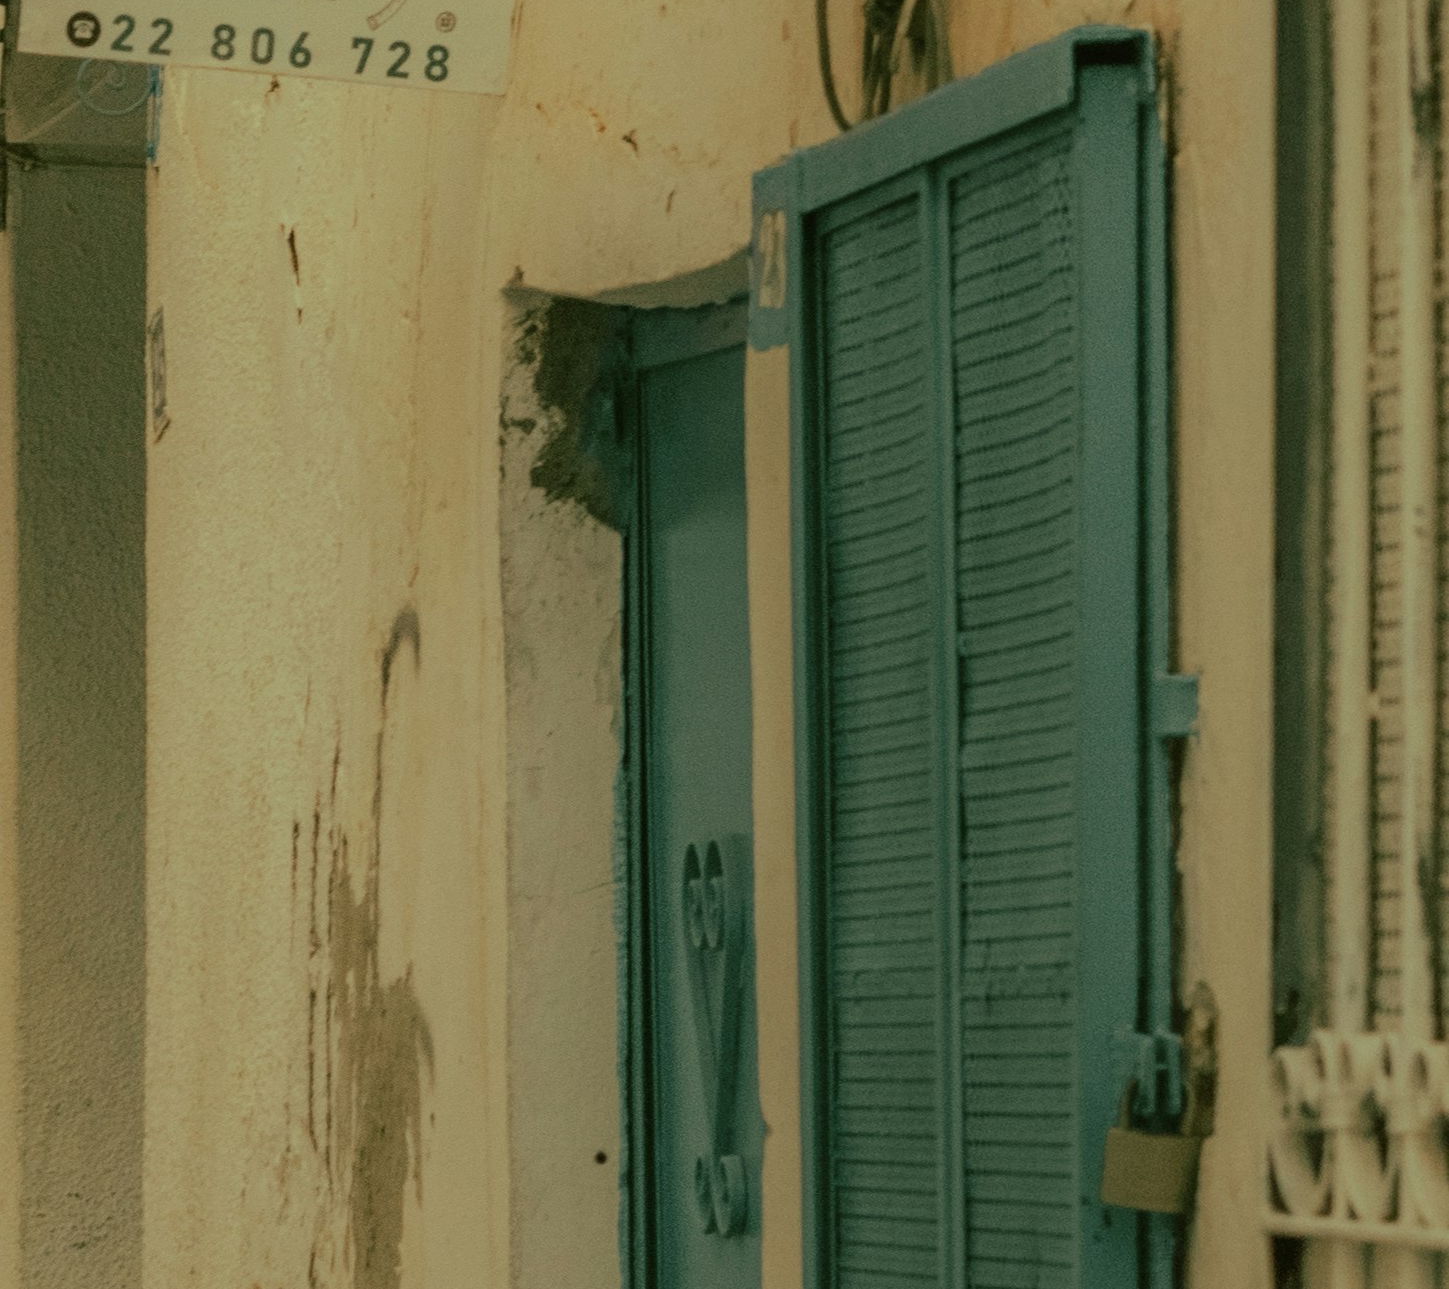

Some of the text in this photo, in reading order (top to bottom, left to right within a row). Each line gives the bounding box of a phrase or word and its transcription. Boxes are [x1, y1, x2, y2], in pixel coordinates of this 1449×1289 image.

[110, 14, 452, 83] 22 806 728
